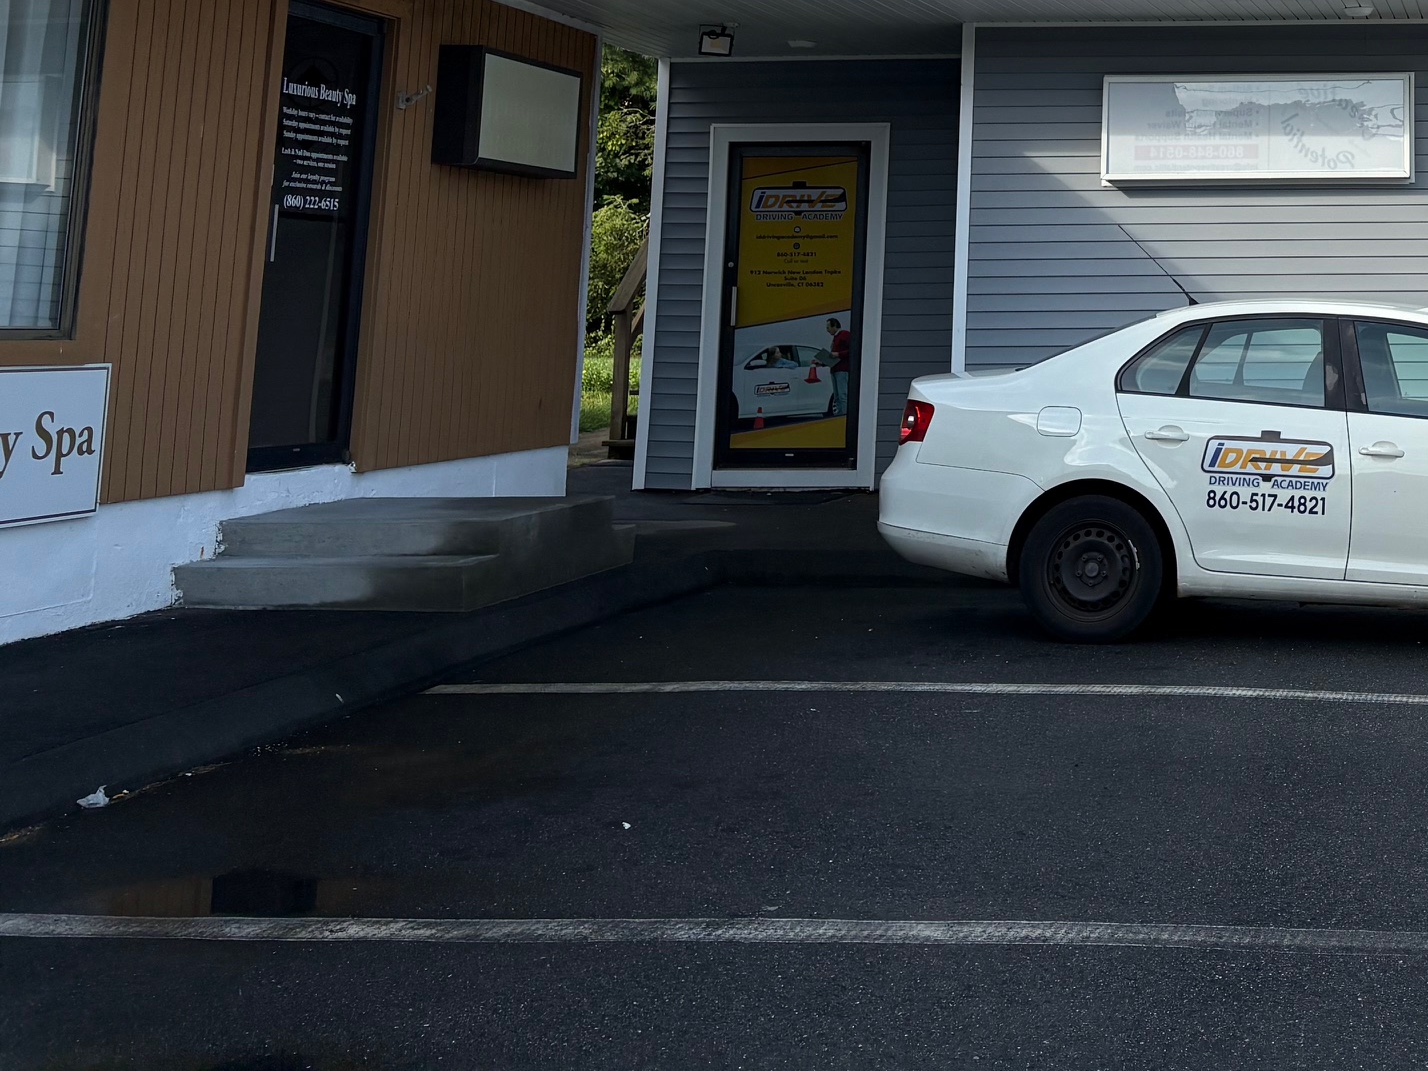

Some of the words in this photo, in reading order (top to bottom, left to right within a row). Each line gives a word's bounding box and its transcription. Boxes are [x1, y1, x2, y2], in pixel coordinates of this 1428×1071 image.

[283, 77, 319, 99] Luxurious
[319, 83, 344, 107] Beauty
[343, 88, 356, 109] Spa
[283, 194, 304, 211] (860)
[305, 195, 339, 211] 222-6515
[755, 213, 793, 221] DRIVING
[31, 410, 96, 476] Spa
[1208, 475, 1260, 488] DRIVING
[1271, 478, 1329, 492] ACADEMY
[1206, 489, 1326, 516] 860-517-4821
